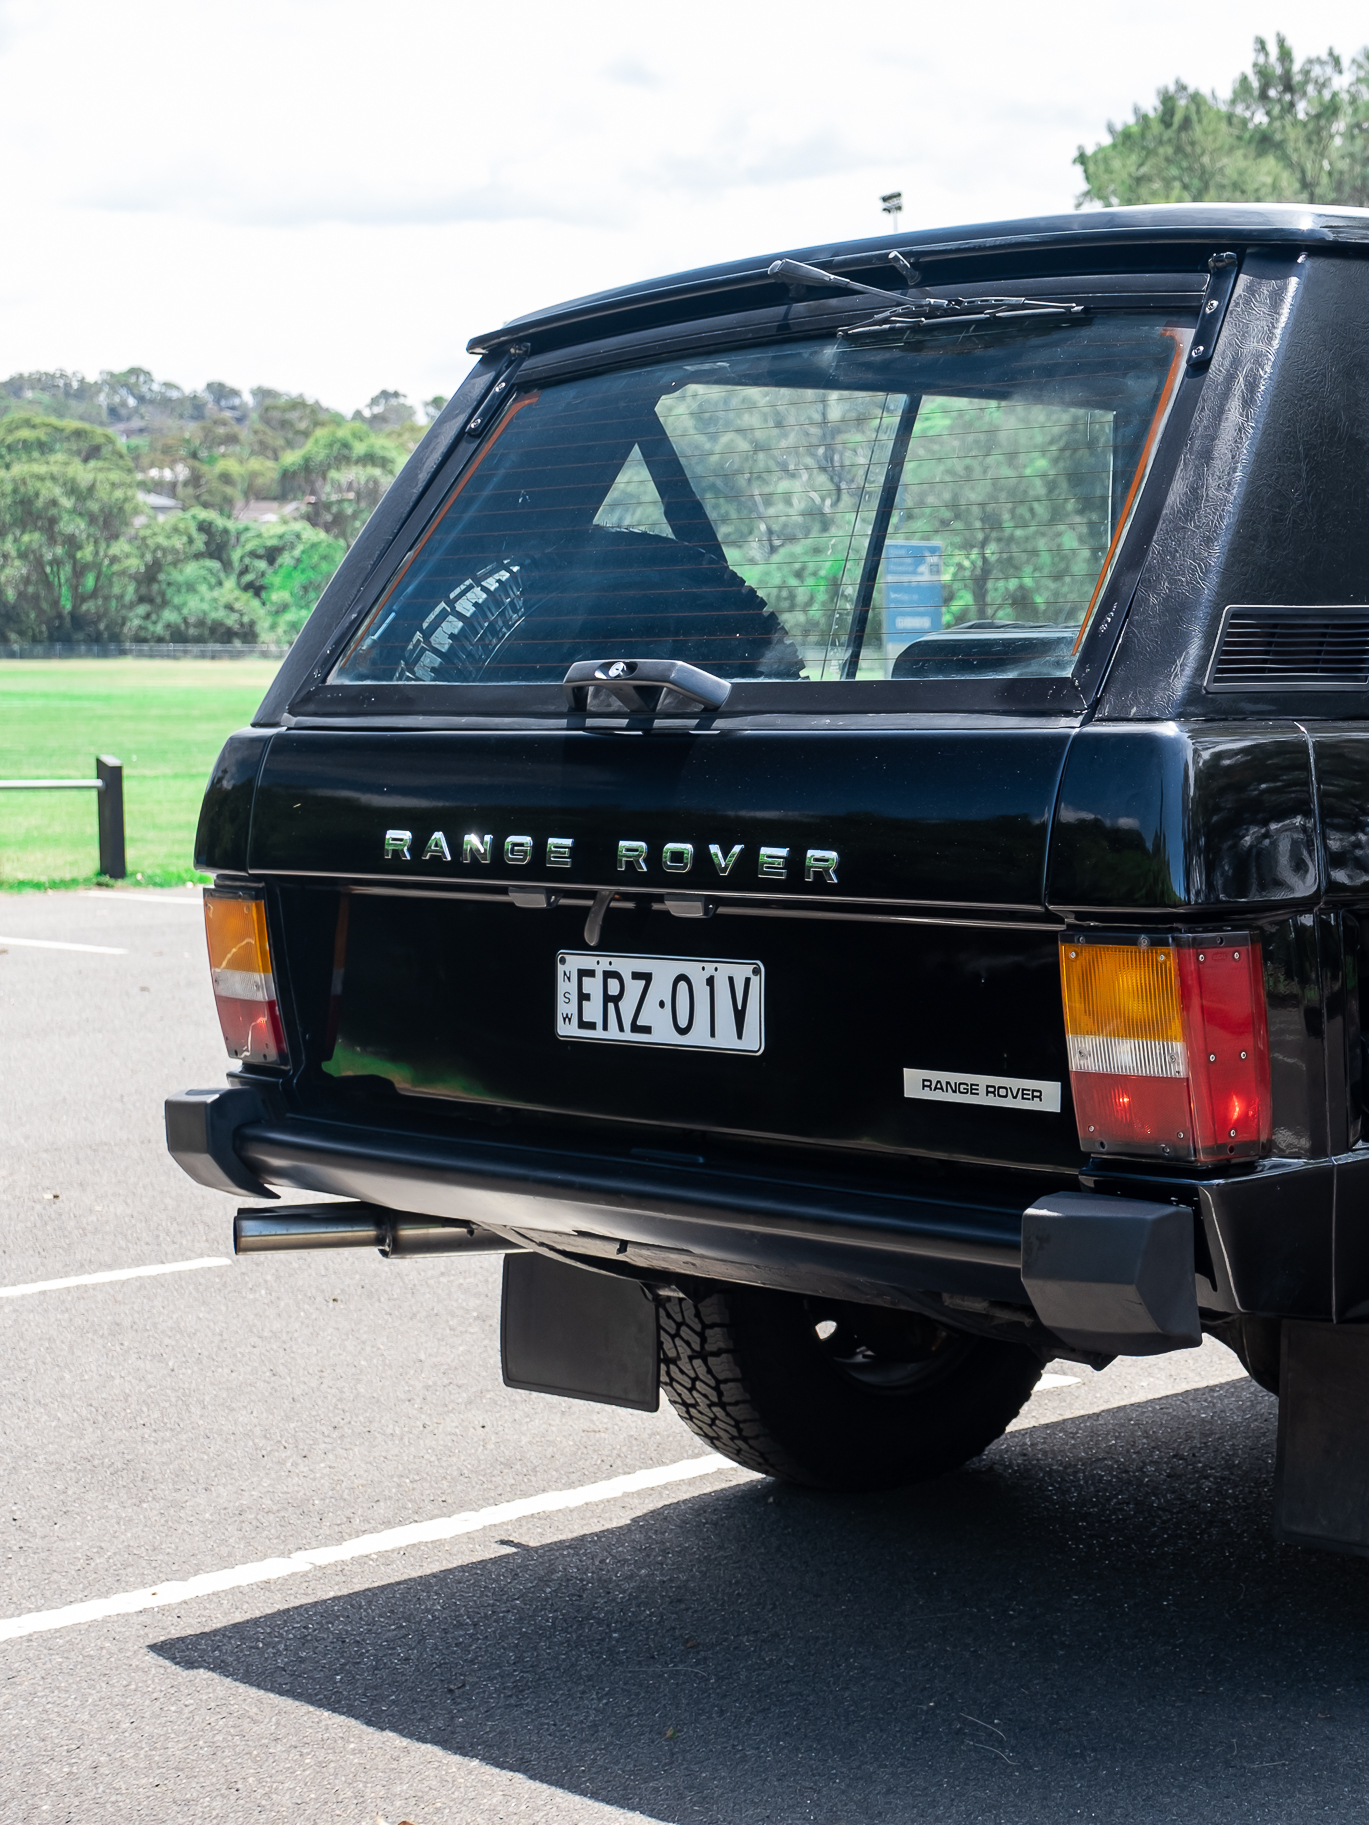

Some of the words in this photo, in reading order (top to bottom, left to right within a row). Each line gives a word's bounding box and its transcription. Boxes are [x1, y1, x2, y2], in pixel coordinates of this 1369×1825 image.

[384, 829, 575, 868] RANGE
[616, 840, 840, 883] ROVER
[921, 1078, 980, 1096] RANGE
[985, 1084, 1043, 1102] ROVER
